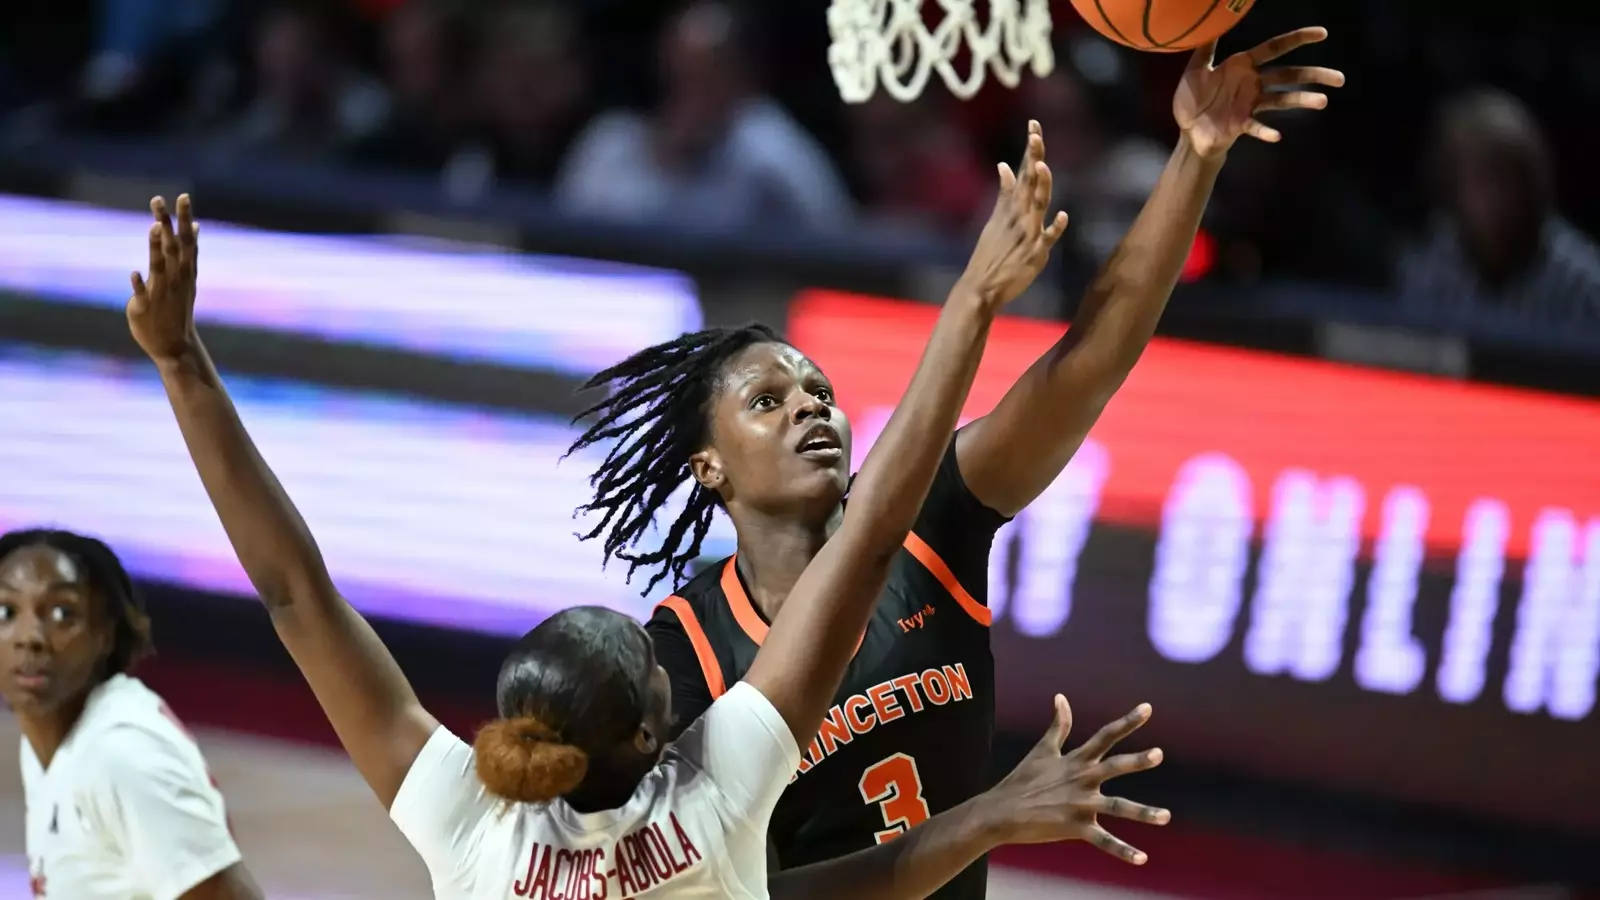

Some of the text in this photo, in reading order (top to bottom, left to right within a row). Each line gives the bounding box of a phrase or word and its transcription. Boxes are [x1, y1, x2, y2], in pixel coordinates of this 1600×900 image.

[897, 611, 924, 634] Ivy
[788, 662, 973, 786] INCETON
[858, 752, 931, 845] 3
[513, 811, 703, 900] JACOBS-ABIOLA
